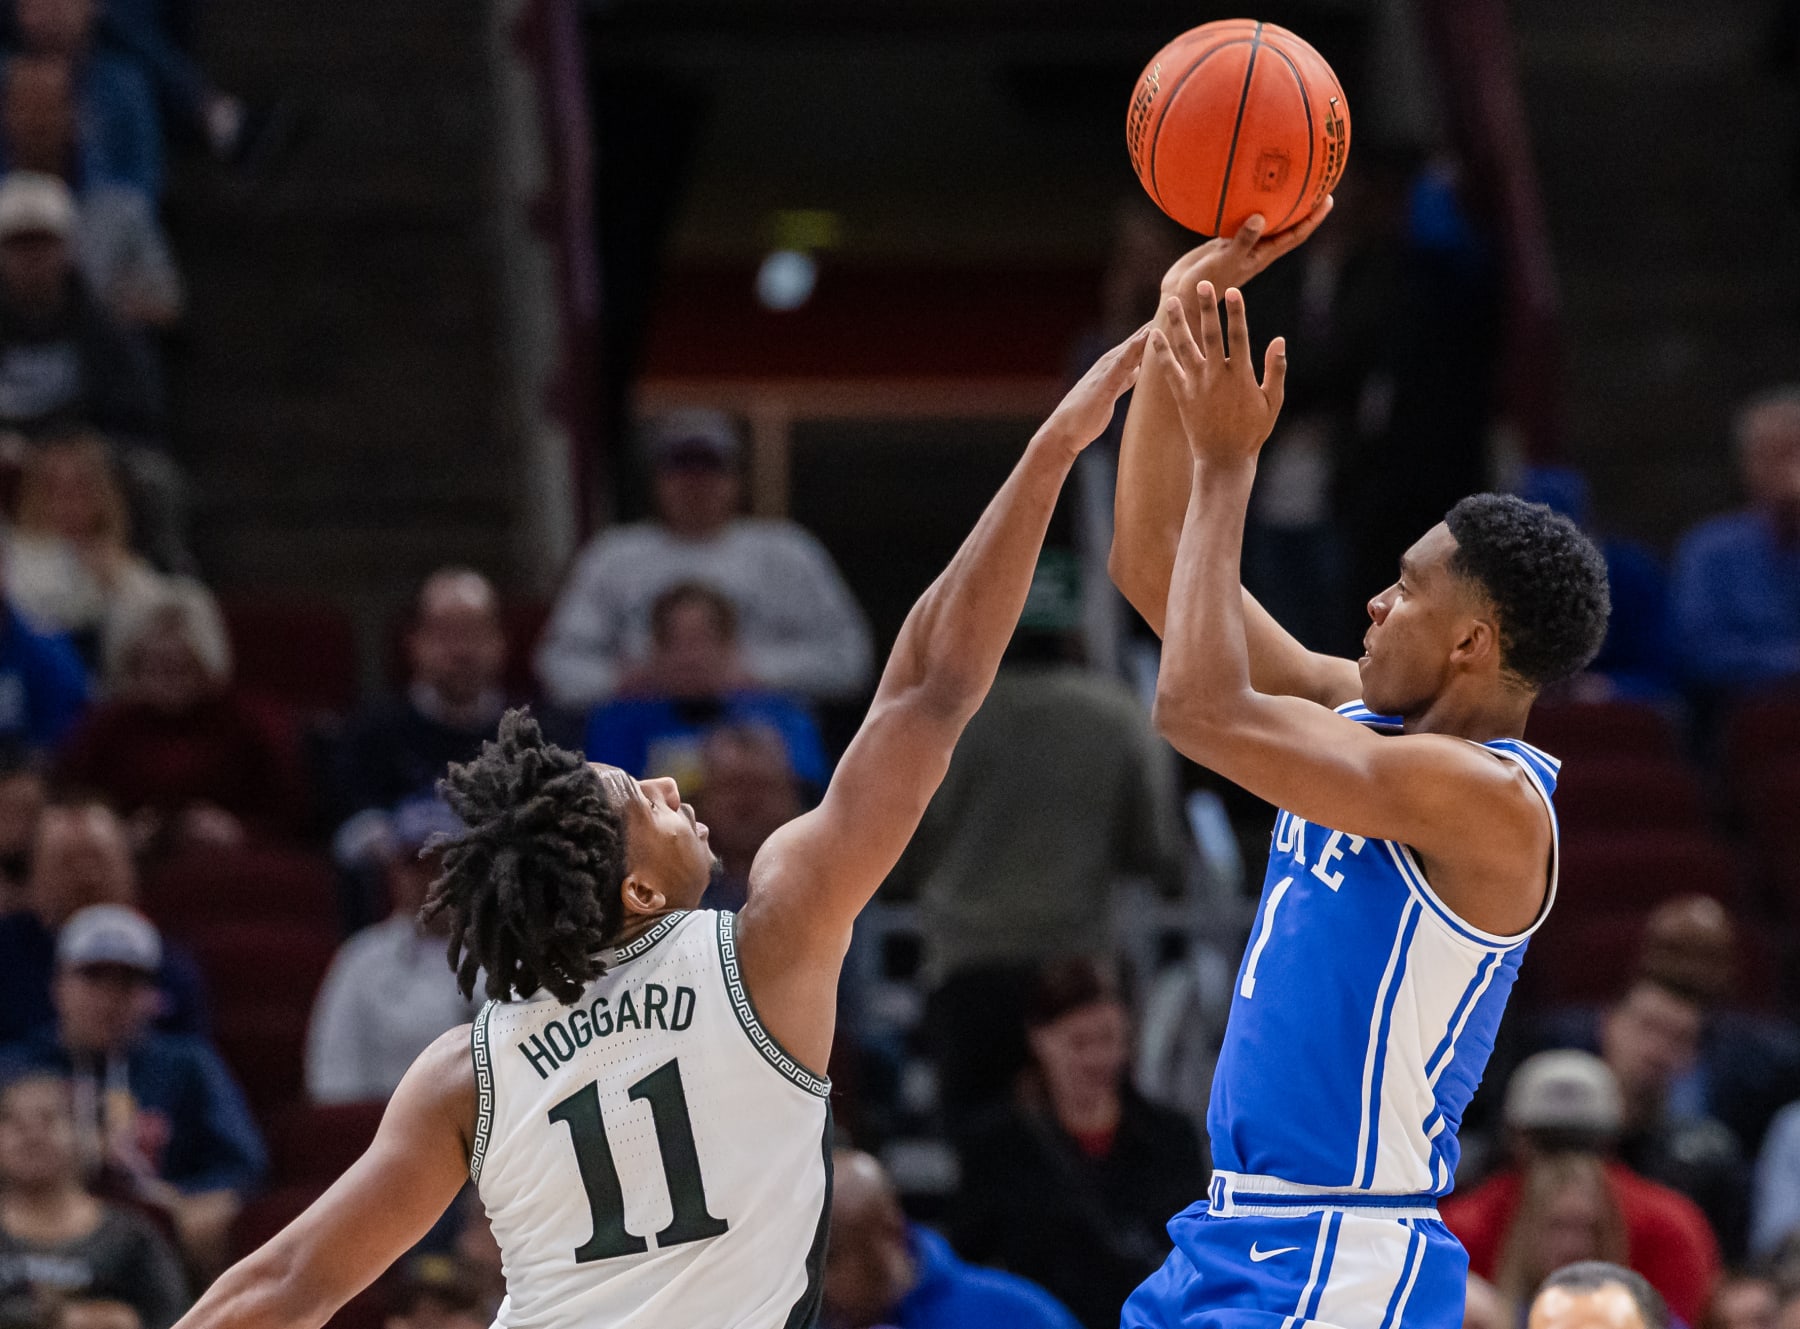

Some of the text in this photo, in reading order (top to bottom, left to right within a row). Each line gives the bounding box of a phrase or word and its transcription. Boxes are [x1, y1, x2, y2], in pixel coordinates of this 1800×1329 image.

[1271, 811, 1366, 892] UE
[1240, 876, 1294, 999] 1
[517, 983, 696, 1080] HOGGARD
[547, 1056, 729, 1264] 11
